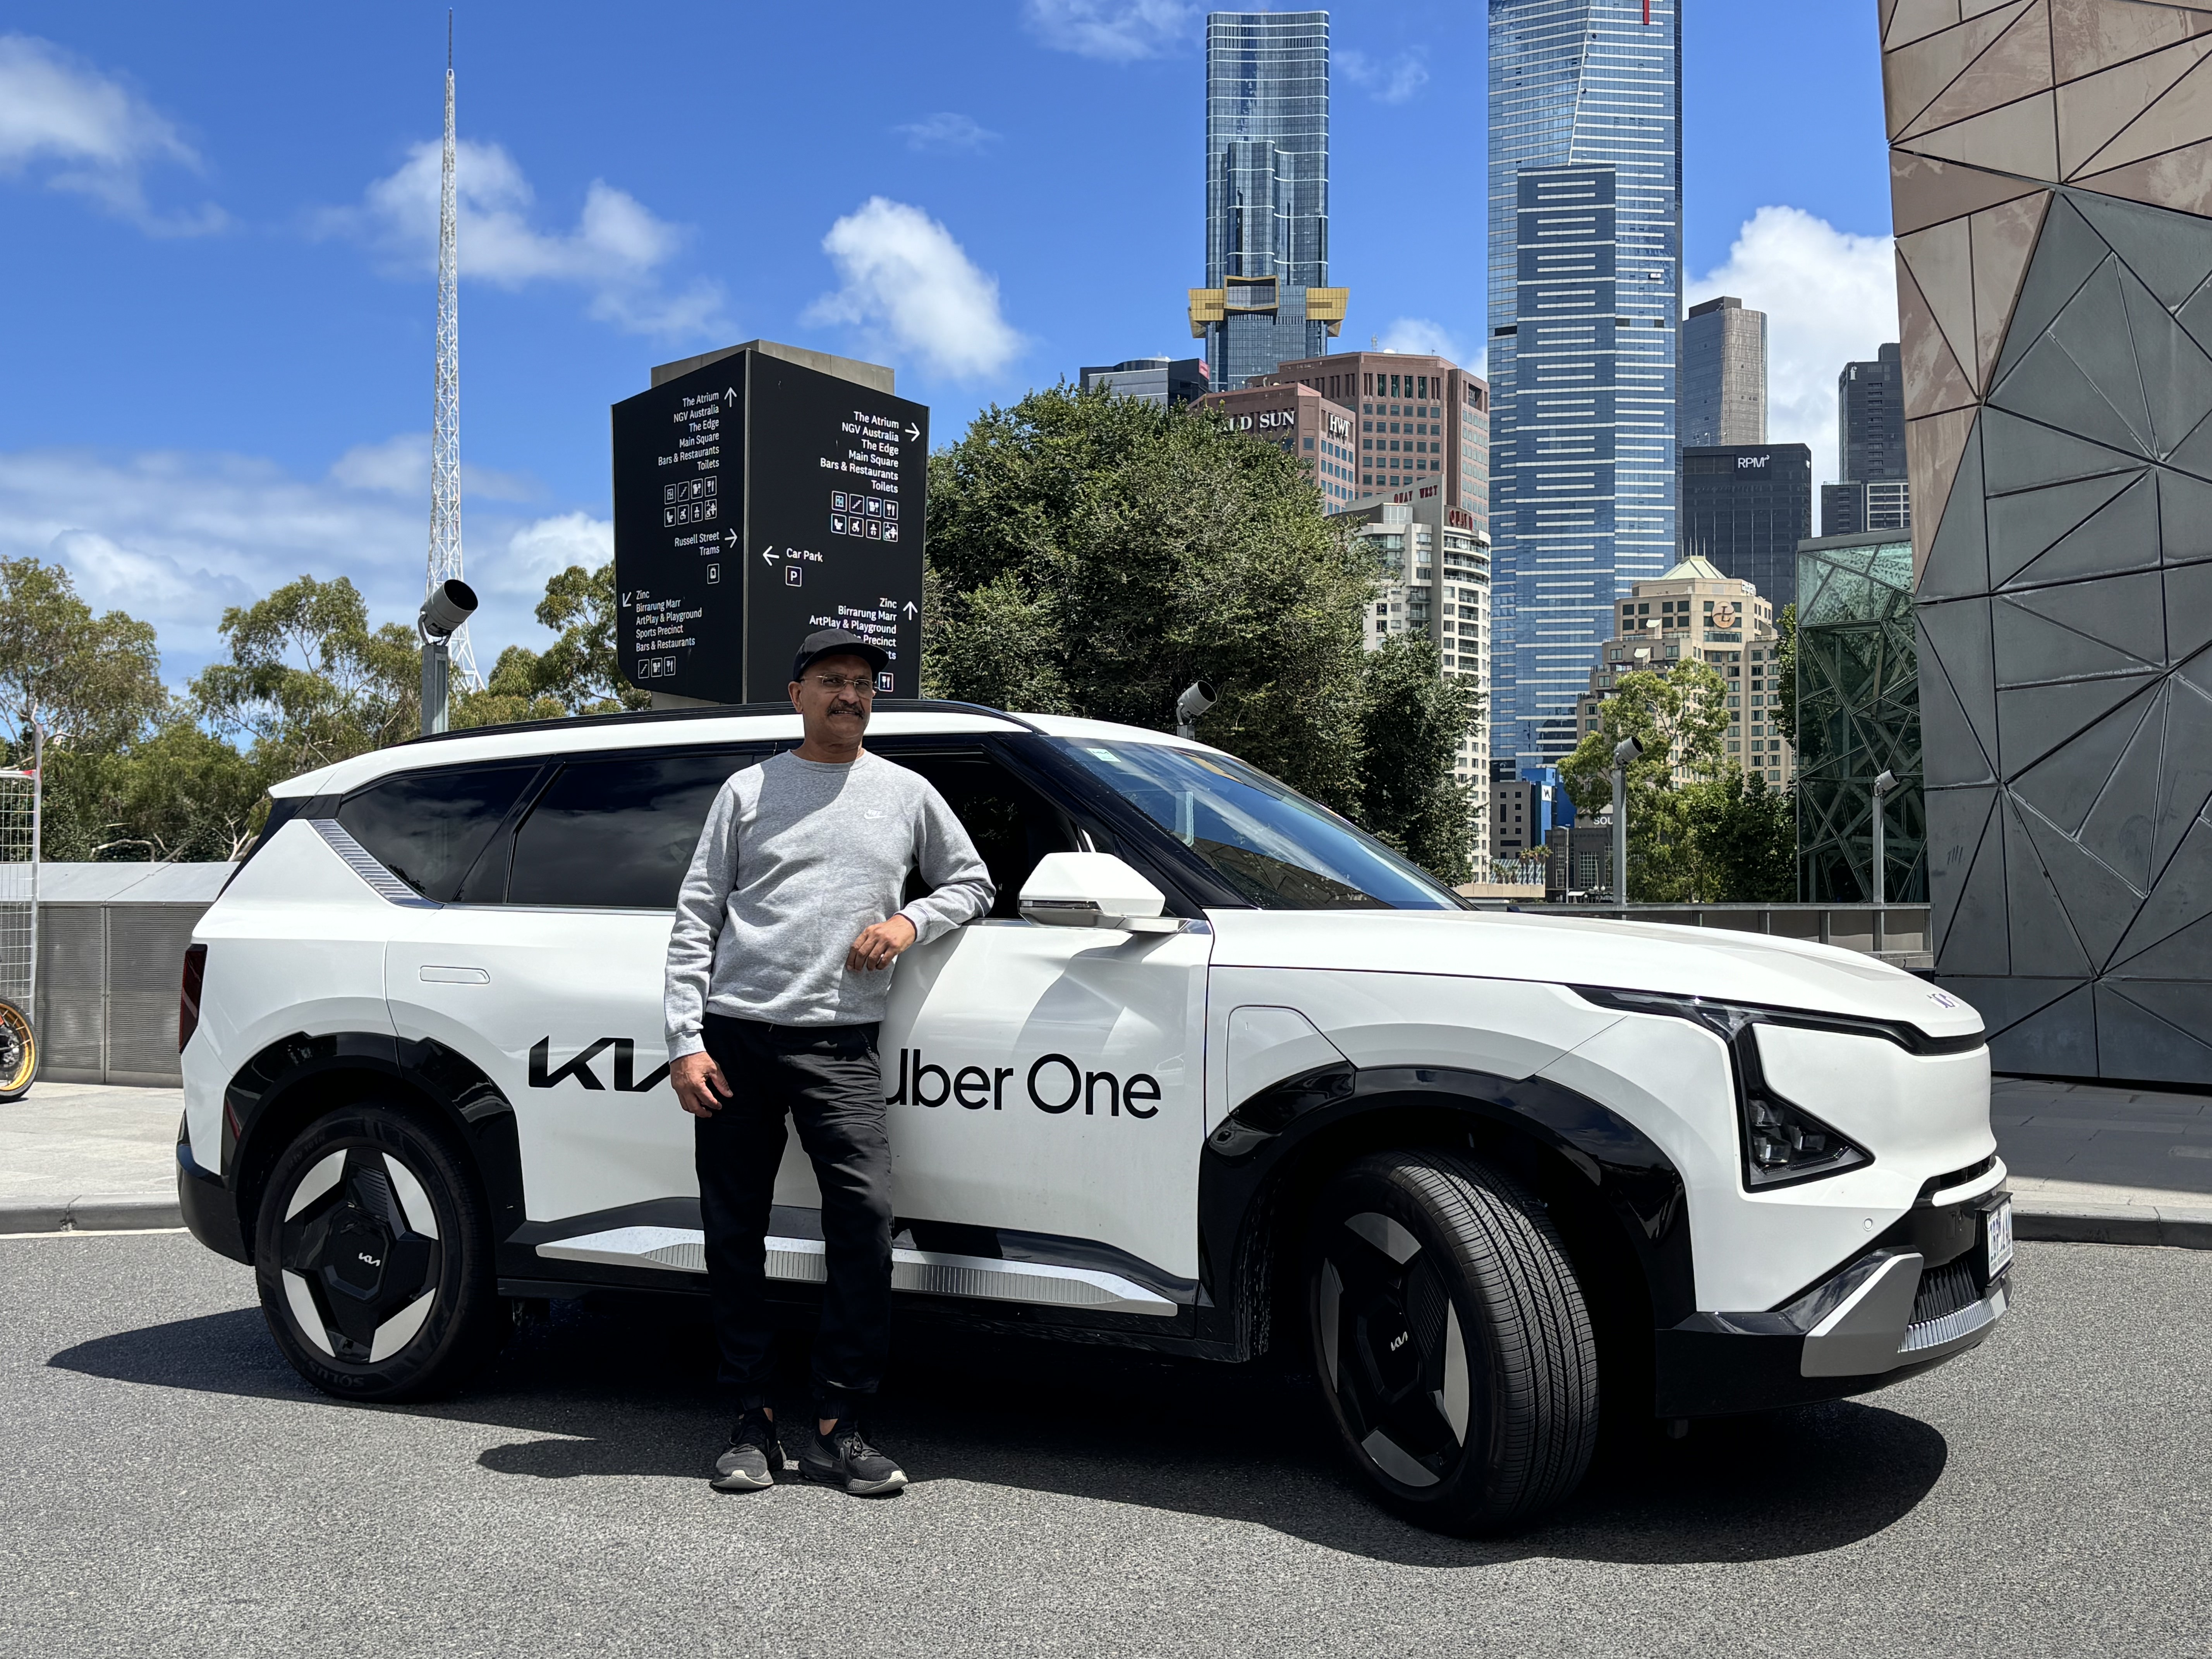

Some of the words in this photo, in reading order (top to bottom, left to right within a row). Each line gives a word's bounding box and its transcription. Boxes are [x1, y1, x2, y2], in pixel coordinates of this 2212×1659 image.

[682, 397, 695, 407] The
[696, 392, 719, 404] Atrium
[674, 411, 688, 423] NGV
[689, 404, 719, 419] Australia
[853, 411, 869, 423] The
[871, 415, 899, 429] Atrium
[1259, 410, 1296, 428] SUN
[689, 422, 701, 432] The
[703, 418, 719, 430] Edge
[842, 422, 861, 434] NGV
[862, 426, 899, 442] Australia
[1329, 414, 1351, 437] HWT
[679, 436, 695, 448] Main
[696, 433, 719, 445] Square
[861, 439, 877, 451] The
[879, 442, 899, 456] Edge
[658, 456, 672, 466] Bars
[673, 453, 678, 462] &
[680, 446, 720, 461] Restaurants
[848, 449, 868, 462] Main
[870, 453, 899, 468] Square
[1738, 457, 1765, 469] RPM
[697, 459, 720, 471] Toilets
[820, 457, 839, 470] Bars
[841, 461, 847, 471] &
[849, 463, 898, 481] Restaurants
[871, 479, 898, 493] Toilets
[1394, 490, 1413, 503] QUAY
[1419, 485, 1438, 499] WEST
[675, 534, 698, 547] Russell
[699, 531, 720, 543] Street
[699, 546, 720, 556] Trams
[786, 548, 802, 559] Car
[804, 550, 823, 562] Park
[636, 590, 650, 600] Zinc
[636, 601, 665, 613] Birrarung
[666, 599, 681, 608] Marr
[879, 598, 897, 609] Zinc
[636, 614, 659, 625] ArtPlay
[660, 613, 665, 622] &
[666, 607, 702, 623] Playground
[838, 605, 877, 621] Birrarung
[878, 610, 897, 621] Marr
[636, 629, 656, 640] Sports
[658, 625, 684, 635] Precinct
[809, 615, 841, 630] ArtPlay
[842, 619, 849, 629] &
[851, 620, 896, 634] Playground
[636, 642, 650, 652] Bars
[651, 641, 656, 650] &
[657, 637, 695, 649] Restaurants
[863, 634, 897, 647] Precinct
[1027, 1053, 1161, 1119] One
